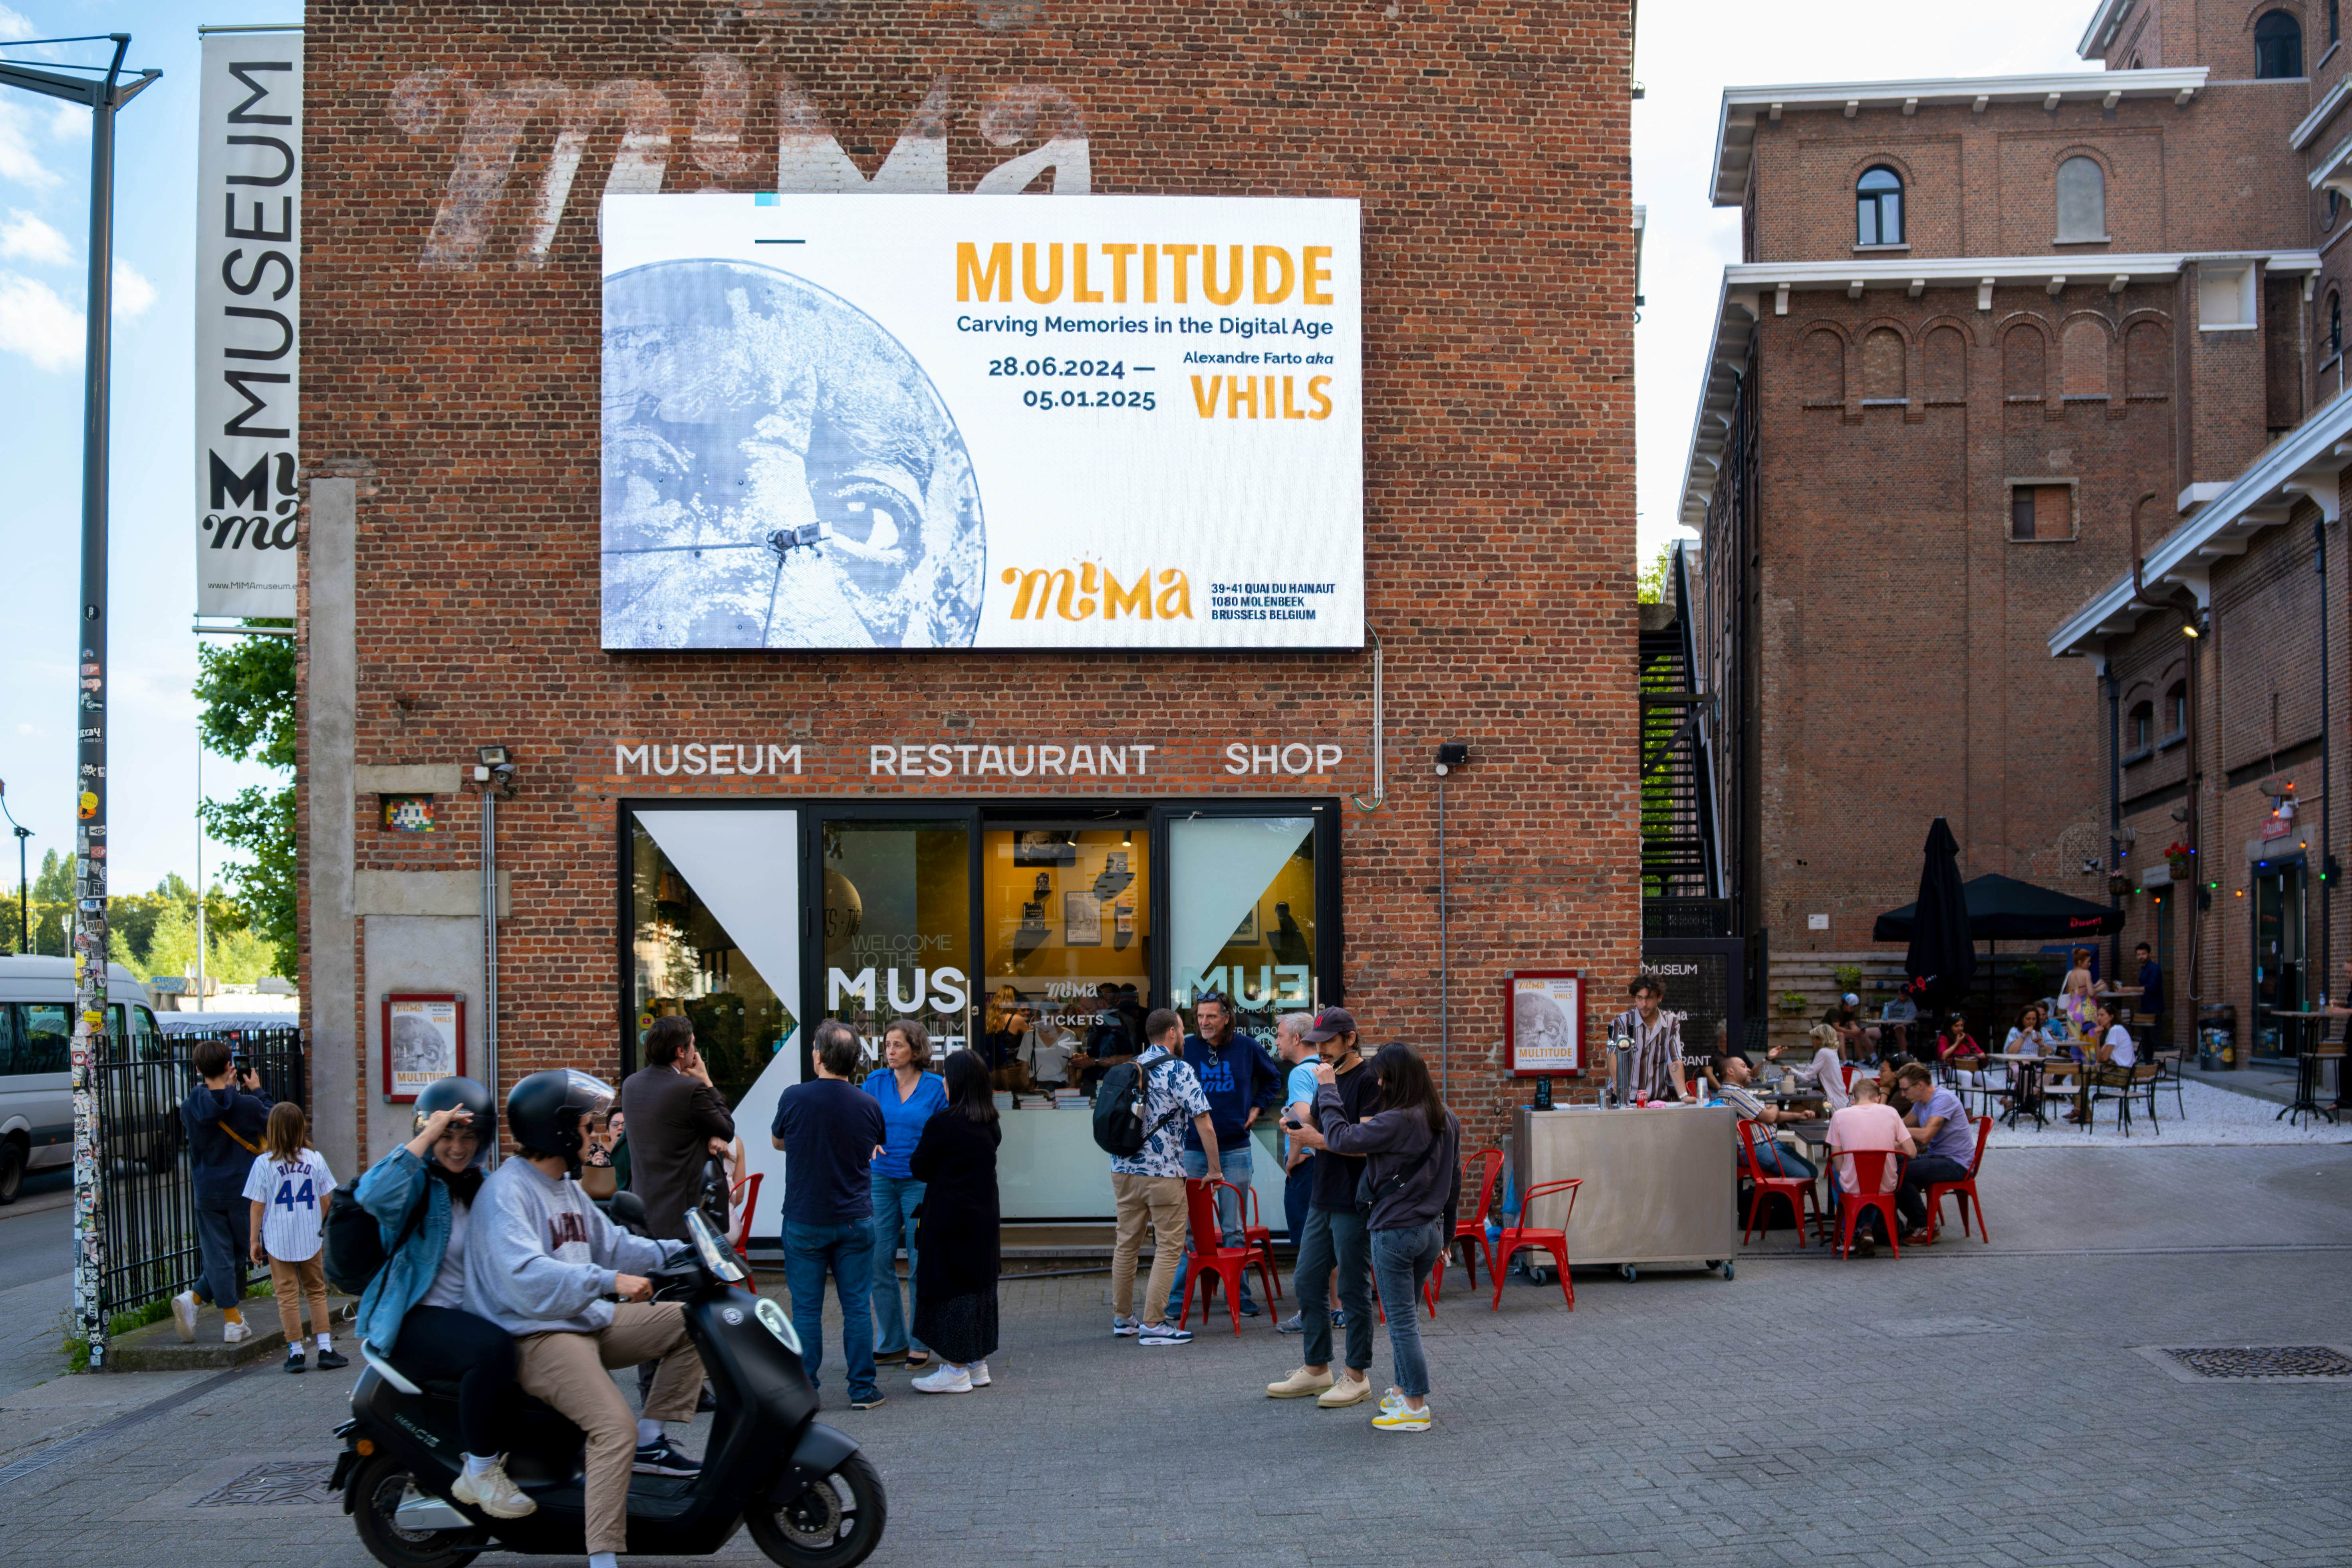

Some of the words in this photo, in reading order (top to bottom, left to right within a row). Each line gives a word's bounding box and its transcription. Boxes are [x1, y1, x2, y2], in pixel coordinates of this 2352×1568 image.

[222, 60, 295, 439] MUSEUM
[957, 242, 1334, 306] MULTITUDE
[957, 315, 1038, 337] Carving
[1045, 316, 1148, 333] Memories
[1155, 316, 1172, 333] in
[1179, 316, 1213, 333] the
[1220, 317, 1289, 339] Digital
[1293, 318, 1334, 339] Age
[1183, 351, 1260, 364] Alexandre
[1264, 352, 1302, 364] Farto
[1306, 352, 1334, 365] aka
[988, 356, 1125, 379] 28.06.2024
[1023, 390, 1156, 411] 05.01.2025
[1190, 375, 1333, 421] VHILS
[208, 582, 298, 590] www.MIMAmuseum.e
[1212, 584, 1242, 594] 39-41
[1245, 584, 1270, 594] QUAI
[1272, 584, 1287, 594] DU
[1289, 584, 1335, 594] HAINAUT
[1212, 597, 1238, 607] 1080
[1241, 596, 1304, 607] MOLENBEEK
[1211, 609, 1266, 620] BRUSSELS
[1269, 609, 1316, 620] BELGIUM
[616, 743, 801, 776] MUSEUM
[871, 744, 1155, 776] RESTAURANT
[1225, 743, 1342, 775] SHOP
[851, 934, 953, 951] WELCOME
[883, 952, 921, 968] THE
[1645, 965, 1697, 975] MUSEUM
[828, 967, 966, 1013] MUS
[1041, 1015, 1104, 1026] TICKETS
[1519, 1048, 1572, 1058] MULTITUDE
[277, 1161, 312, 1177] RIZZO
[275, 1178, 315, 1212] 44
